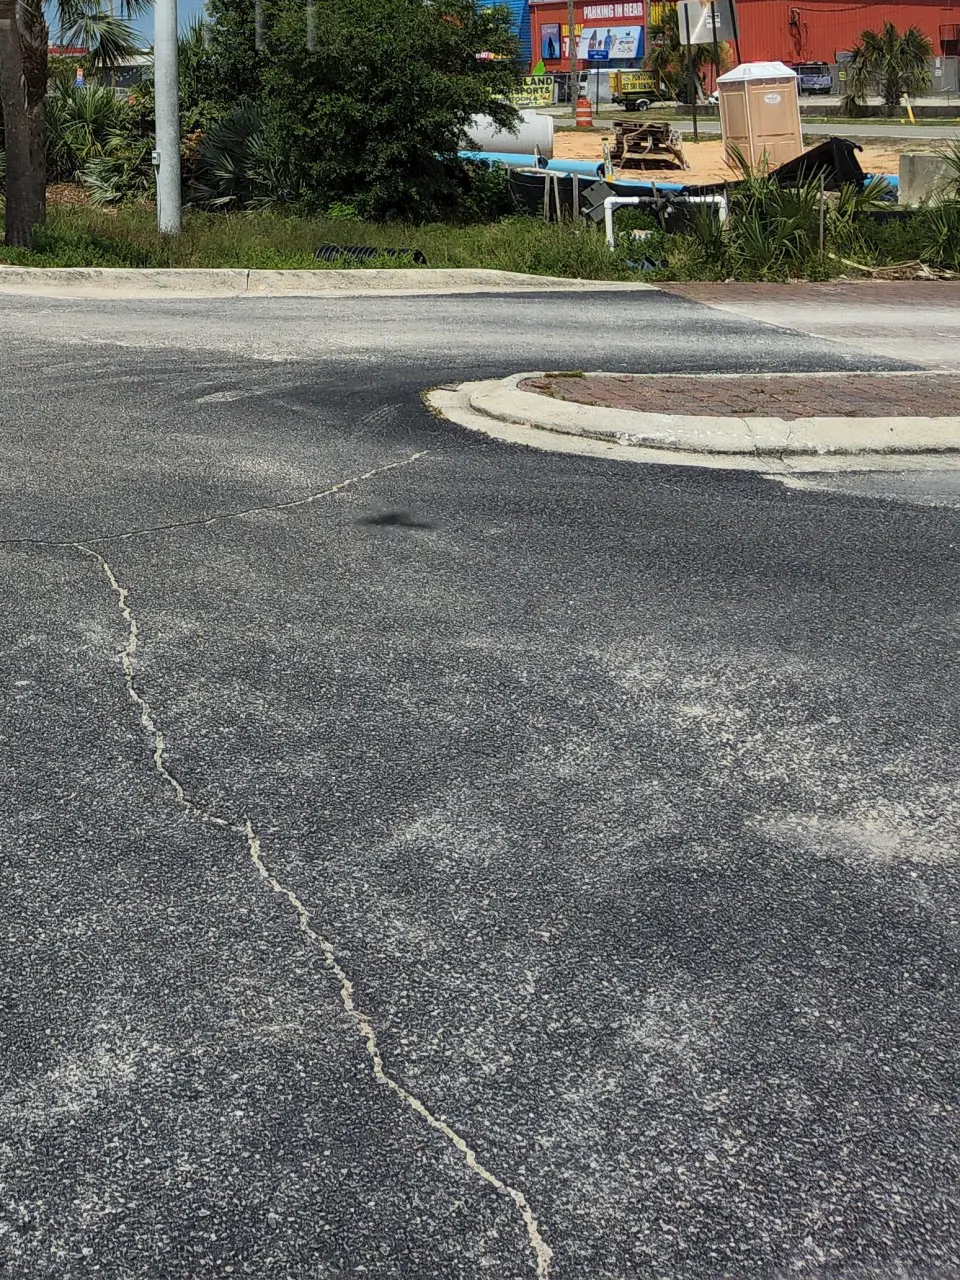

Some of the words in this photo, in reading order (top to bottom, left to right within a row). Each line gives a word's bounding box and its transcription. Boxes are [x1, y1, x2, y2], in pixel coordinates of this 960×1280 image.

[583, 4, 614, 19] PARKING
[614, 3, 623, 18] IN
[624, 2, 643, 17] REAR
[516, 77, 553, 86] SLAND
